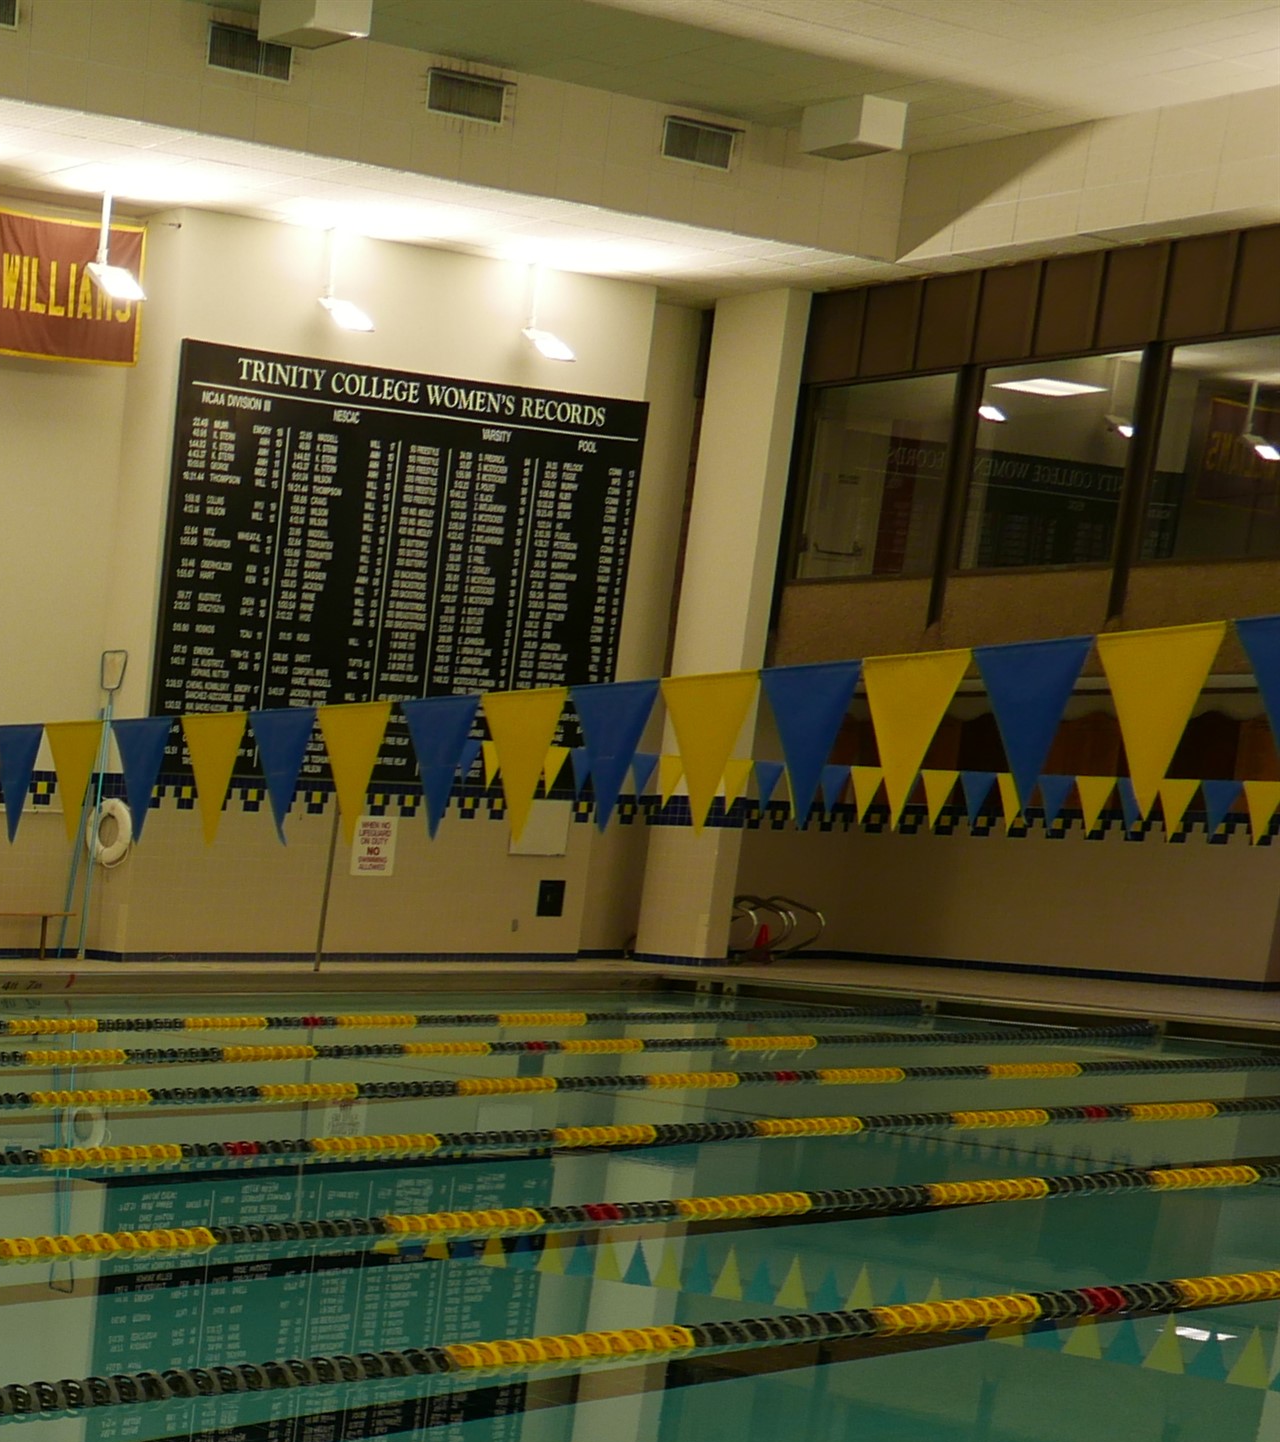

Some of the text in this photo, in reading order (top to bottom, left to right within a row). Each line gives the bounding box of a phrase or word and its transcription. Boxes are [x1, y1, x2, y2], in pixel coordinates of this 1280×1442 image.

[201, 391, 225, 406] NCAA
[226, 394, 262, 411] DIVISION
[237, 357, 607, 427] TRINITY COLLEGE WOMEN'S RECORDS
